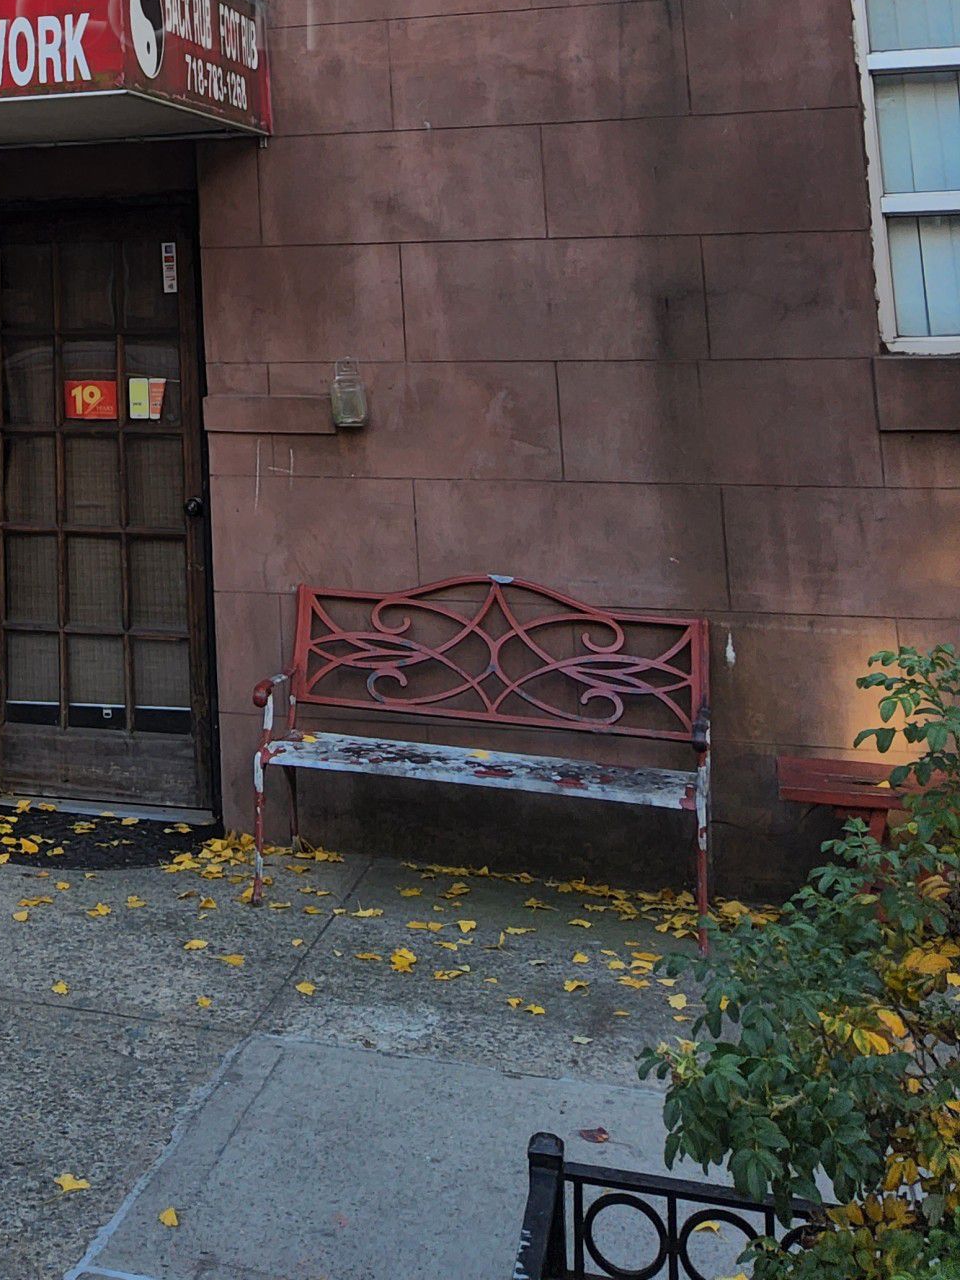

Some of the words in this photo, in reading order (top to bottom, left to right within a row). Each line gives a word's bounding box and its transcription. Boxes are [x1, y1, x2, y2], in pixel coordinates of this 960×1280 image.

[219, 3, 240, 62] FOOT
[241, 14, 258, 70] RUB
[71, 384, 102, 415] 19
